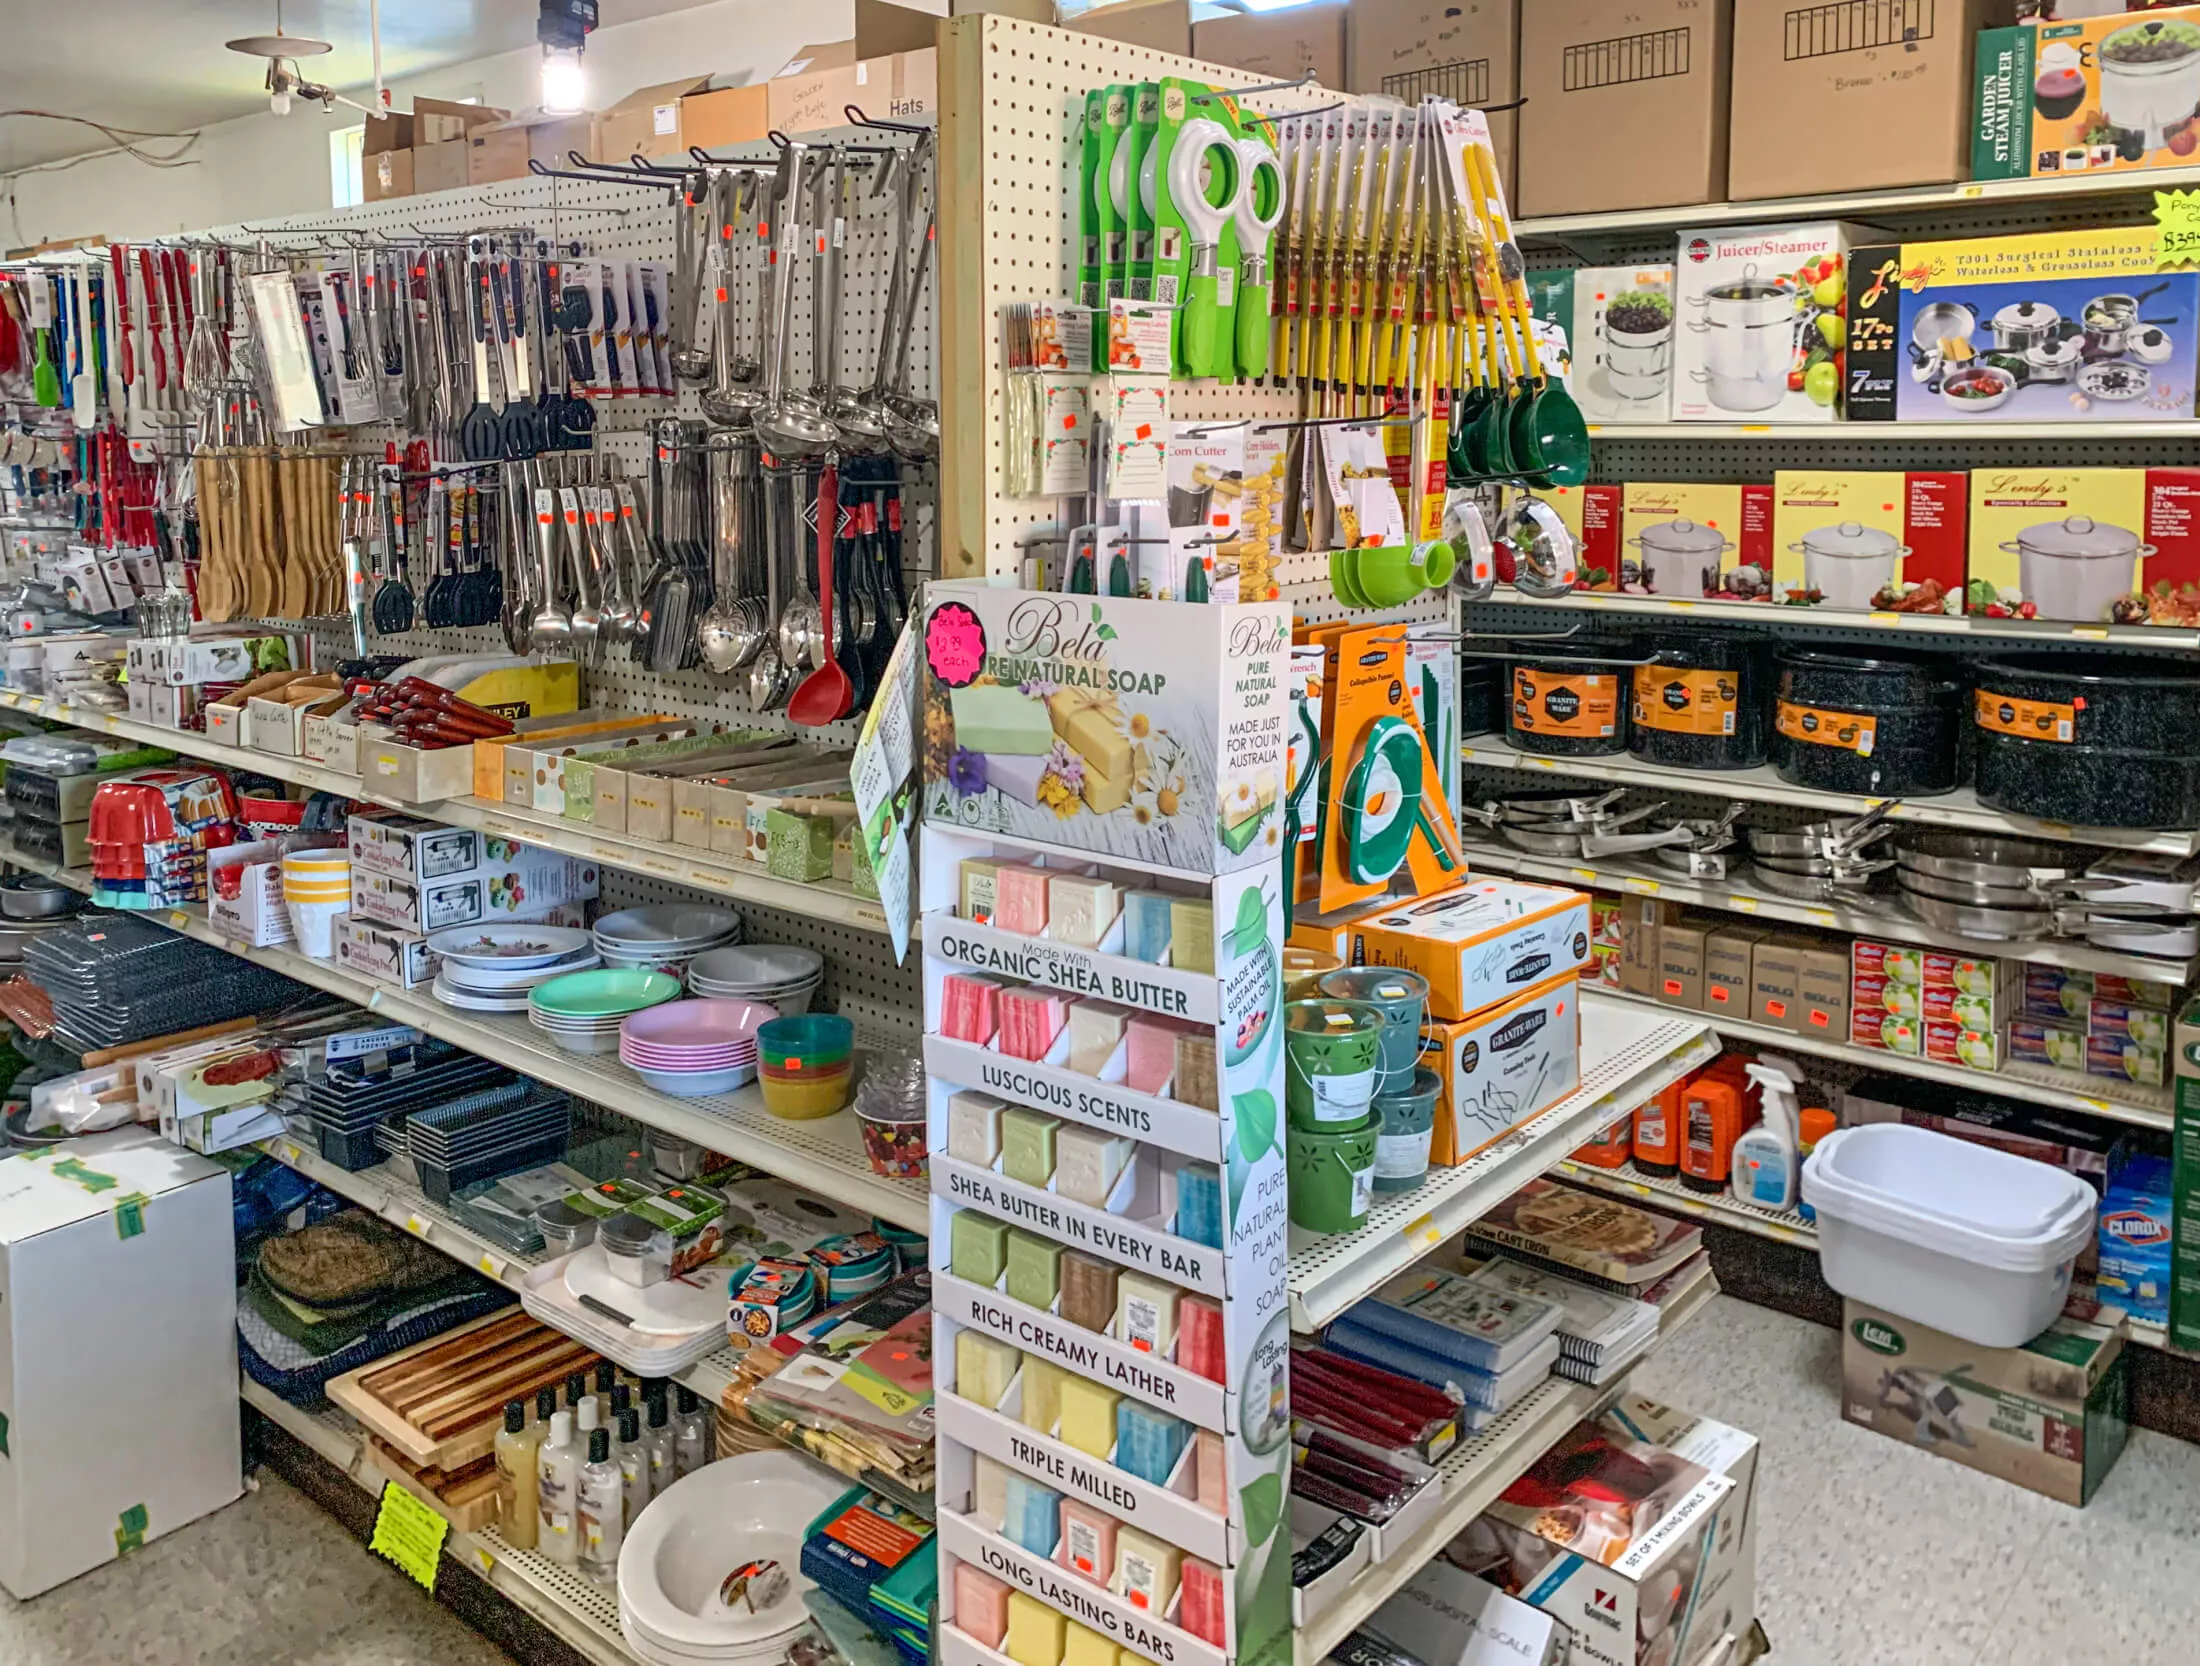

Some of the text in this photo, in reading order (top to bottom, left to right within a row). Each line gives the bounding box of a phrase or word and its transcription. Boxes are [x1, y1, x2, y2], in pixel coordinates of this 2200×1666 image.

[890, 99, 924, 116] Hats
[1981, 75, 1996, 141] GARDEN
[1995, 50, 2013, 162] STEAM JUICER
[1716, 240, 1828, 261] Juicer/Steamer
[1997, 250, 2060, 262] Surgical
[2068, 245, 2142, 258] Stainless
[1956, 264, 2019, 277] Waterless
[1195, 446, 1227, 457] Cutter
[1005, 597, 1107, 662] Bela
[1228, 615, 1283, 659] Bela
[943, 656, 969, 668] each
[1247, 661, 1270, 676] PURE
[1014, 659, 1102, 689] NATURAL
[1108, 669, 1166, 696] SOAP
[1235, 676, 1277, 693] NATURAL
[1243, 693, 1271, 708] SOAP
[1547, 696, 1578, 705] GRANITE
[1229, 716, 1280, 735] MADE JUST
[1227, 732, 1281, 752] FOR YOU IN
[1229, 750, 1278, 769] AUSTRALIA
[1022, 943, 1092, 969] Made With
[1226, 945, 1268, 995] MADE WITH
[1663, 962, 1698, 977] SOLO
[941, 936, 1188, 1015] ORGANIC SHEA BUTTER
[1227, 956, 1273, 1014] SUSTAINABLE
[1709, 971, 1744, 985] SOLO
[1237, 979, 1271, 1021] PALM OIL
[1757, 982, 1795, 998] SOLO
[1492, 1013, 1545, 1049] GRANITE-WARE
[982, 1064, 1151, 1133] LUSCIOUS SCENTS
[1258, 1167, 1285, 1201] PURE
[950, 1173, 1202, 1281] SHEA BUTTER IN EVERY BAR
[1234, 1196, 1286, 1247] NATURAL
[2109, 1220, 2162, 1236] CLOROX
[1252, 1222, 1286, 1263] PLANT
[1497, 1230, 1523, 1248] CAST
[1525, 1237, 1551, 1256] IRON
[1269, 1252, 1287, 1277] OIL
[1256, 1277, 1287, 1316] SOAP
[972, 1301, 1013, 1335] RICH
[1019, 1321, 1098, 1369] CREAMY
[1105, 1356, 1176, 1403] LATHER
[1255, 1340, 1274, 1362] Long
[1262, 1341, 1288, 1369] Lasting
[1010, 1437, 1136, 1512] TRIPLE MILLED
[1625, 1552, 1643, 1568] SET
[1640, 1541, 1652, 1555] OF
[1655, 1514, 1682, 1543] MIXING
[1679, 1492, 1706, 1521] BOWLS
[981, 1545, 1175, 1662] LONG LASTING BARS
[1433, 1600, 1483, 1635] DIGITAL
[1487, 1627, 1533, 1658] SCALE
